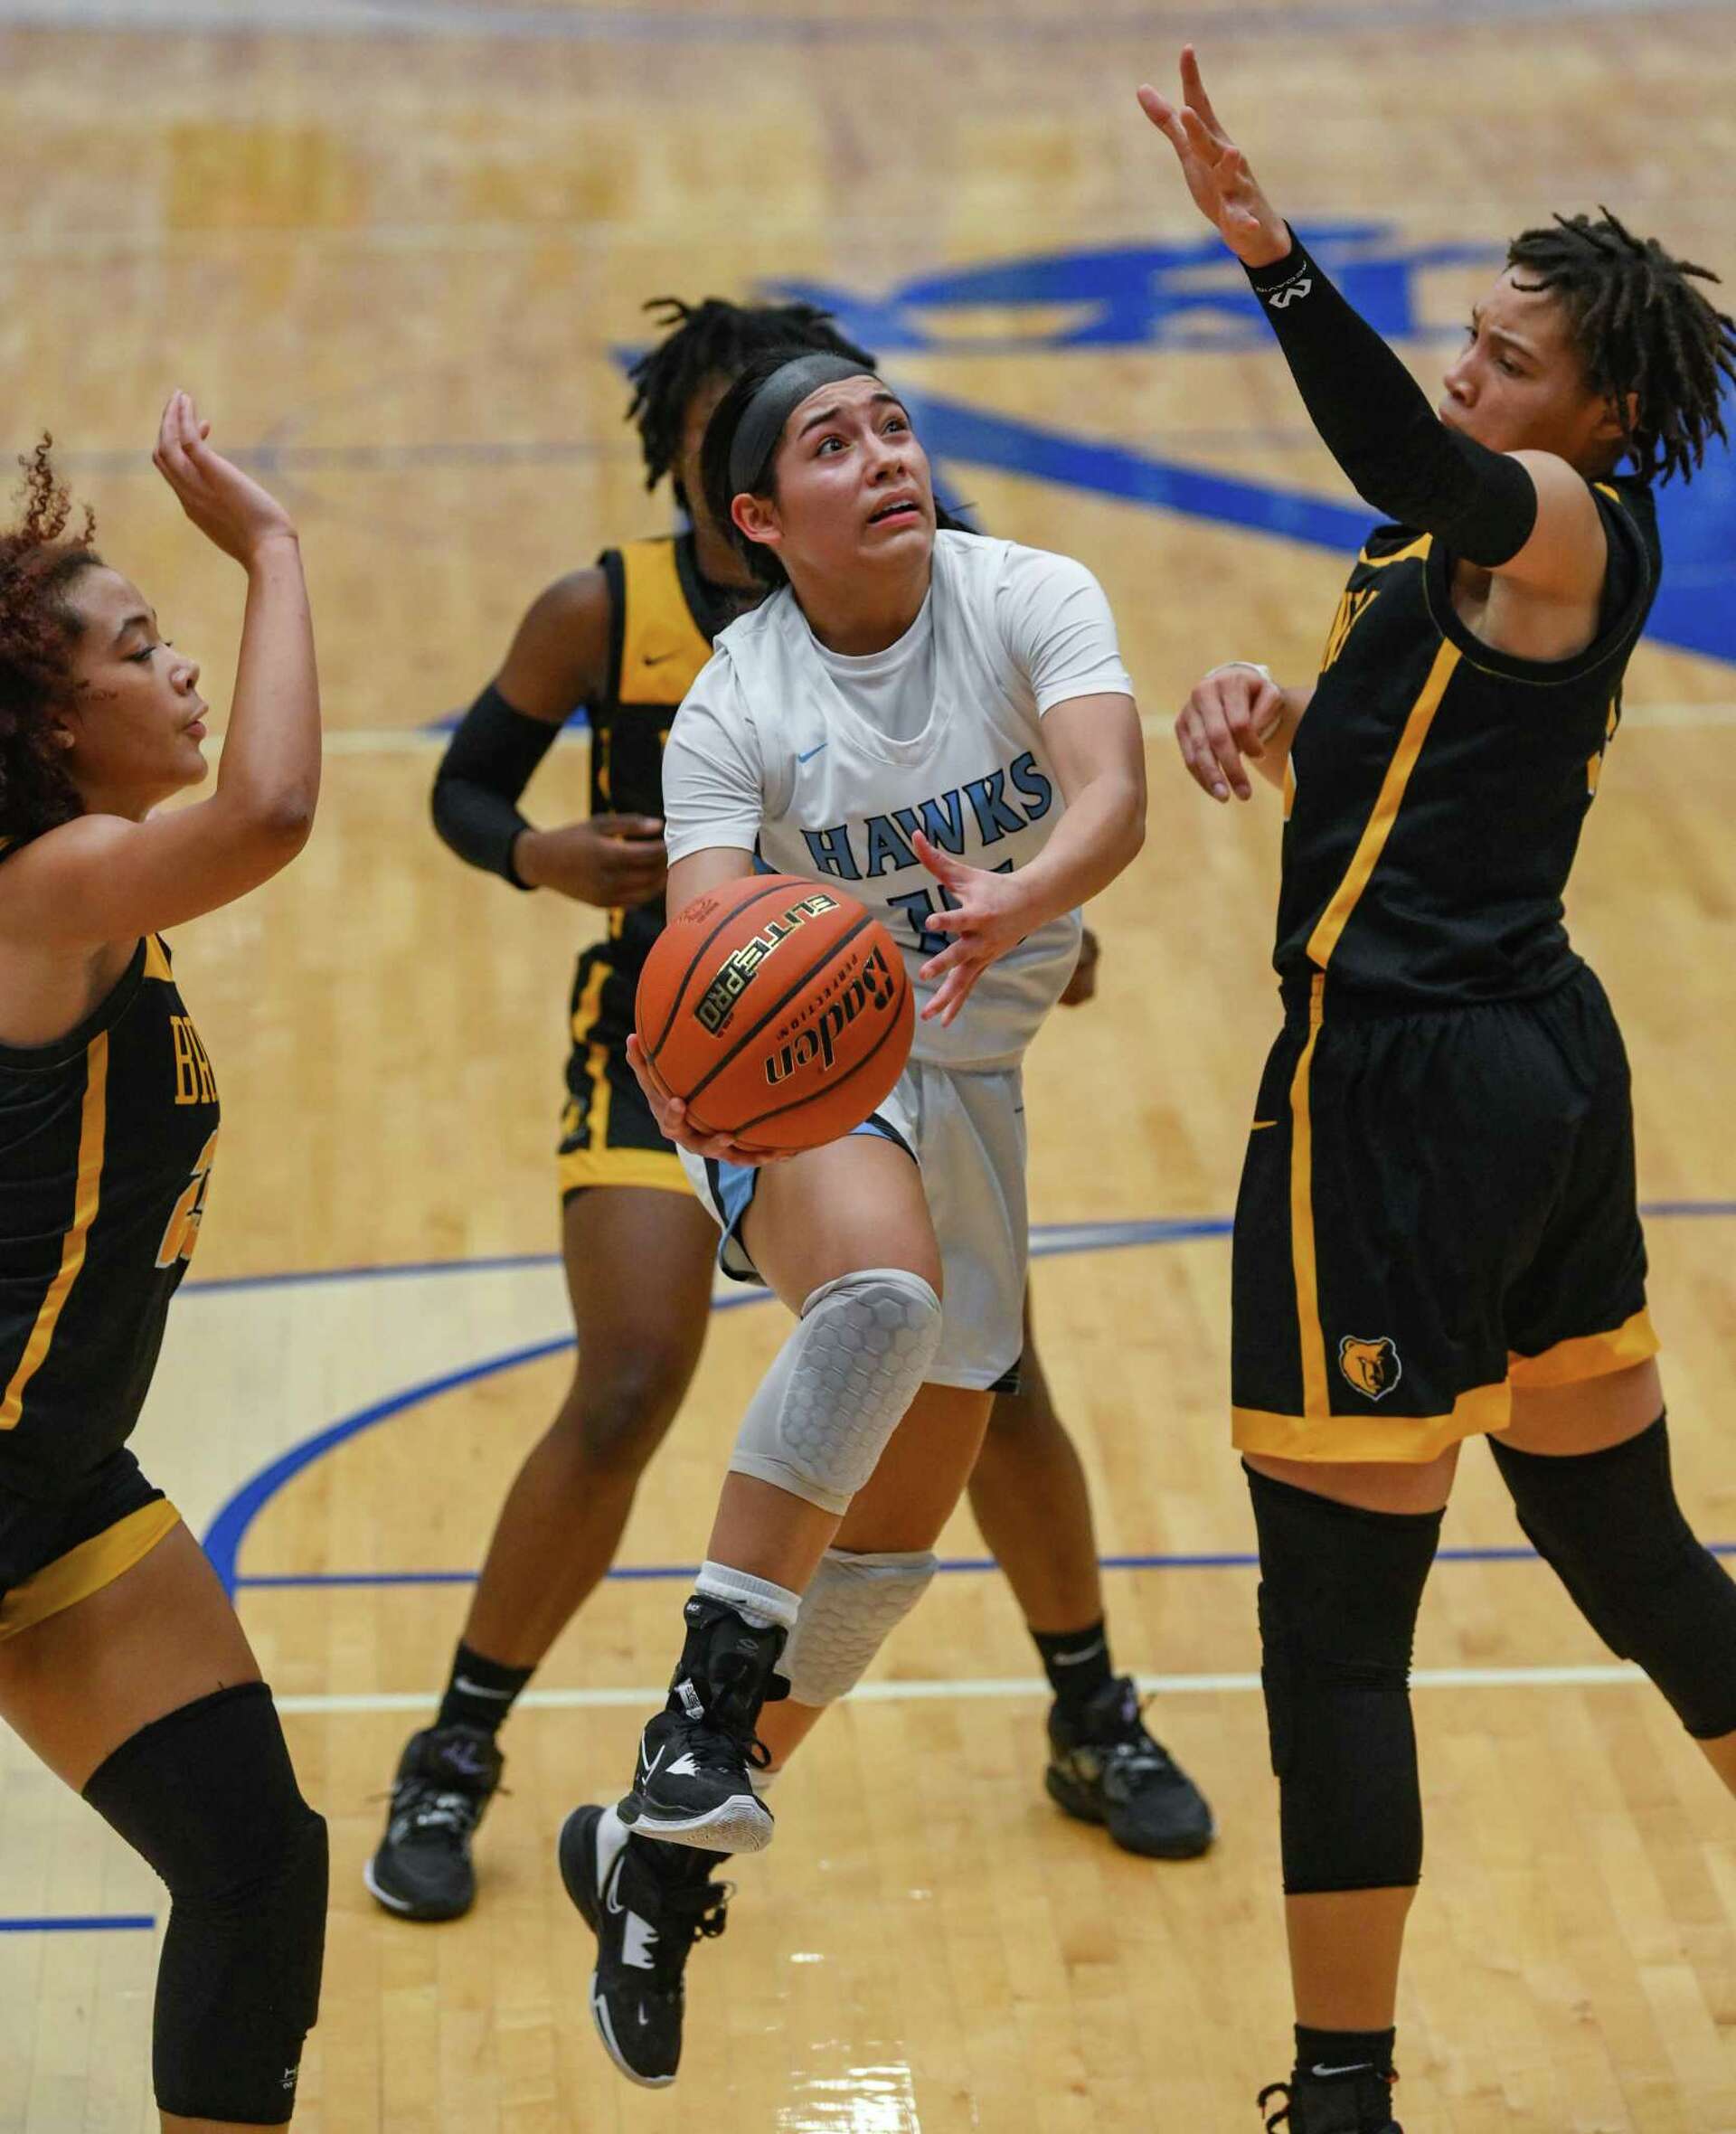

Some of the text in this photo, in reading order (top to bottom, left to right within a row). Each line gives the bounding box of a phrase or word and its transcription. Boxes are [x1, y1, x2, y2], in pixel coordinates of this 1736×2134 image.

[799, 751, 1053, 882] HAWKS
[764, 942, 895, 1086] Baden
[777, 953, 859, 1042] PERFECTION
